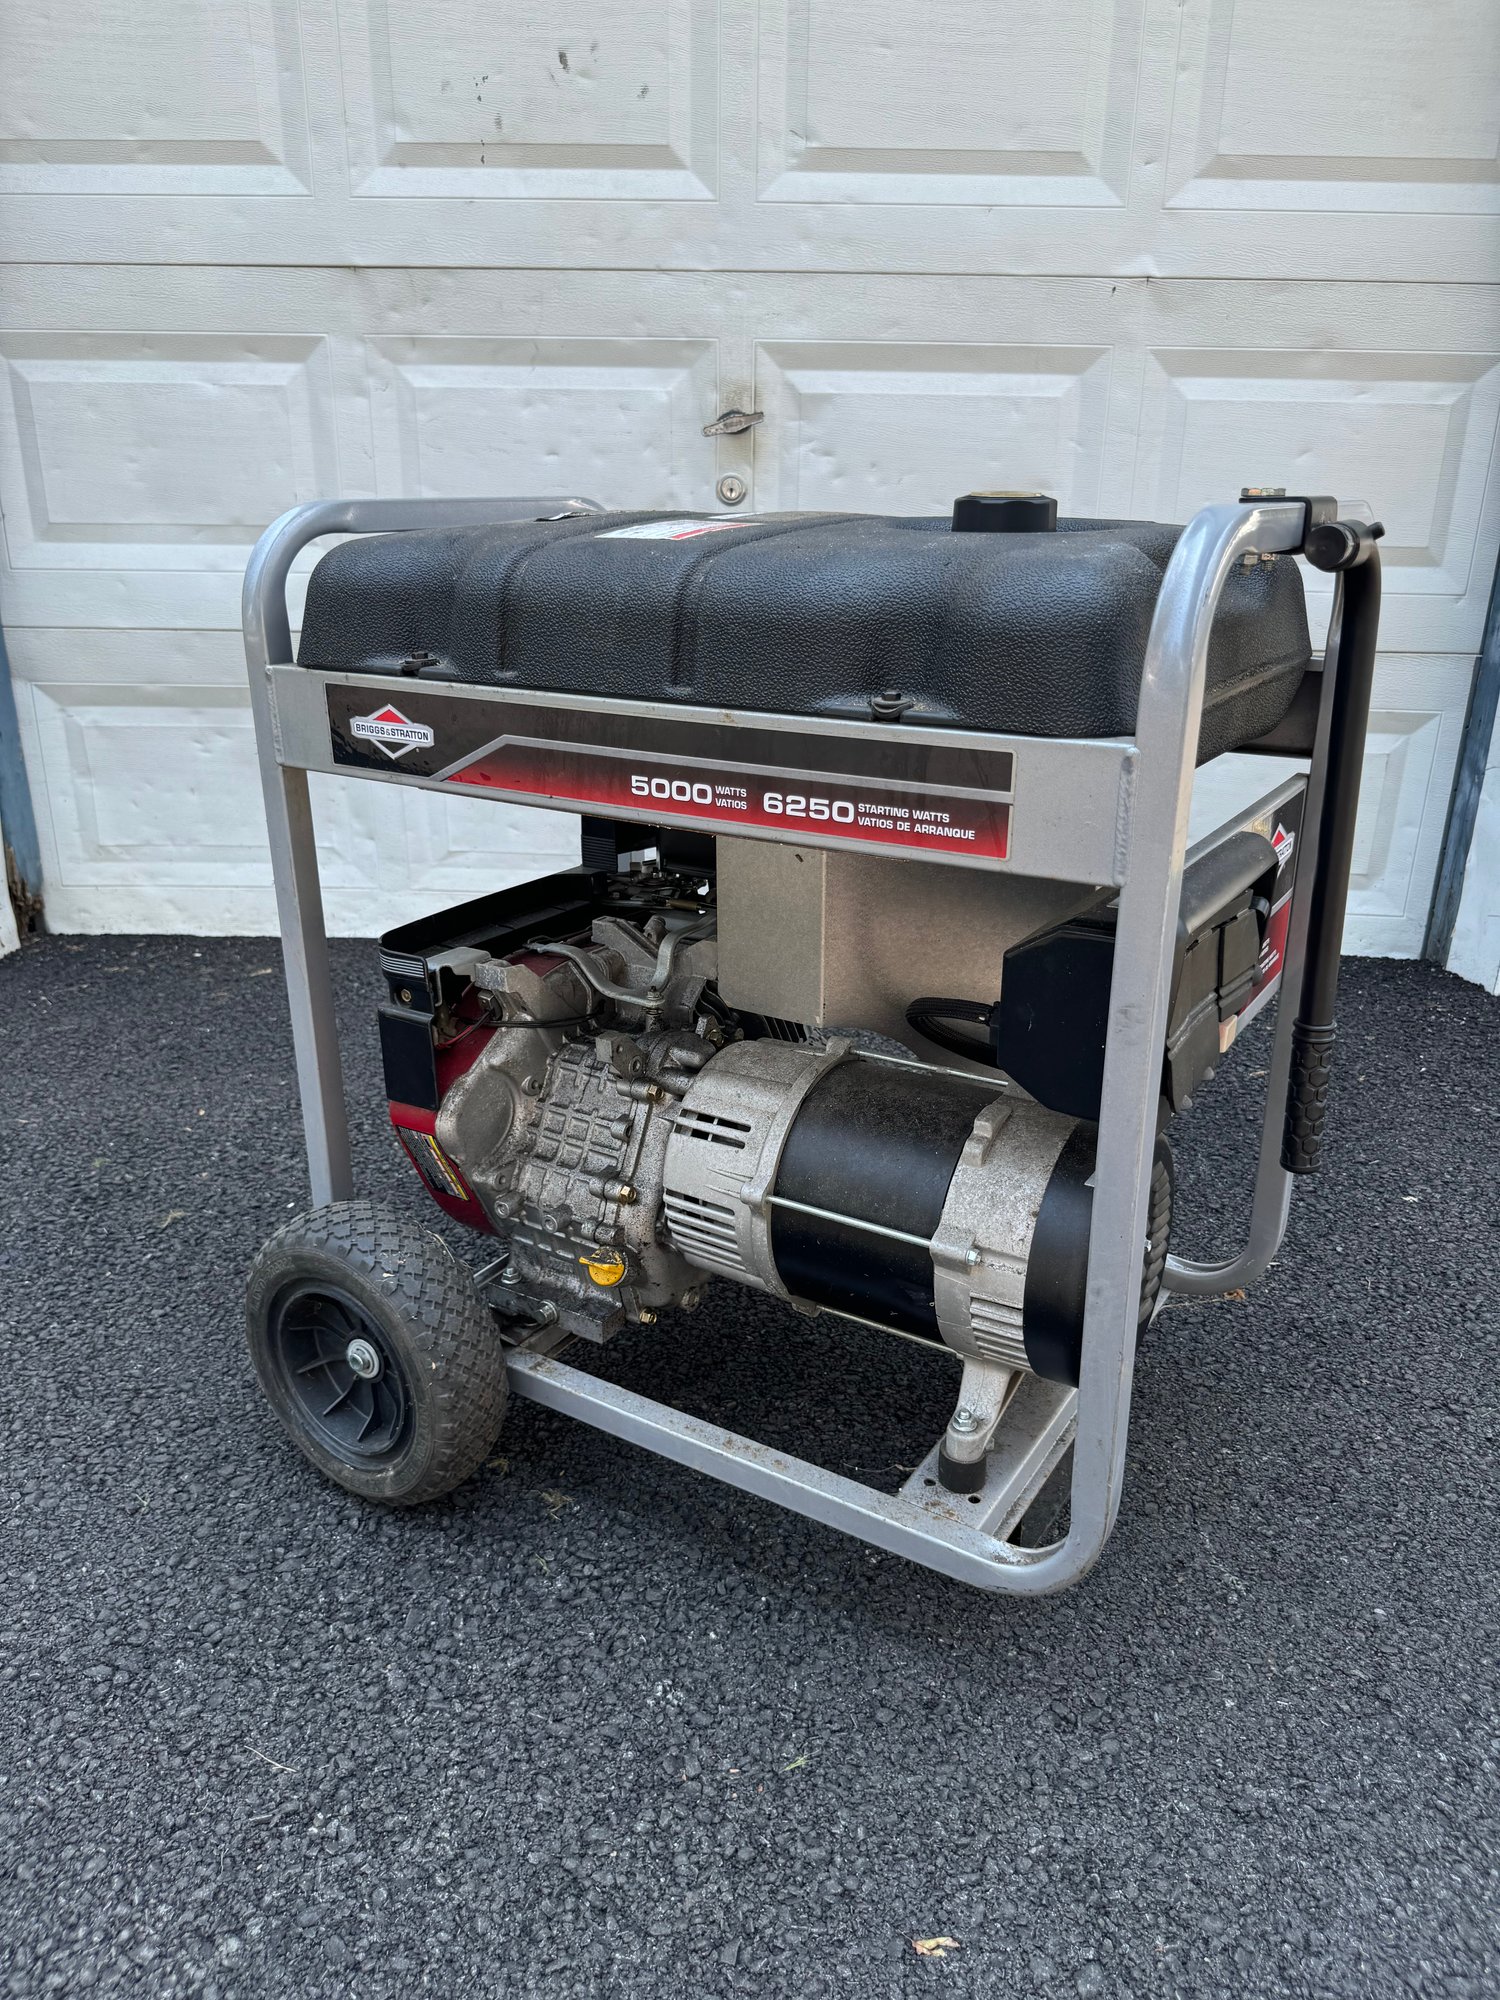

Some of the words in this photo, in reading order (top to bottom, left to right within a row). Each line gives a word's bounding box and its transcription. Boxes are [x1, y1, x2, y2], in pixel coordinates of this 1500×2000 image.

[631, 775, 713, 805] 5000
[715, 785, 747, 798] WATTS
[715, 798, 748, 810] VATIOS
[763, 792, 855, 824] 6250
[858, 803, 909, 818] STARTING
[912, 810, 950, 823] WATTS
[857, 816, 893, 830] VATIOS
[896, 821, 911, 832] DE
[914, 823, 975, 840] ARRANQUE
